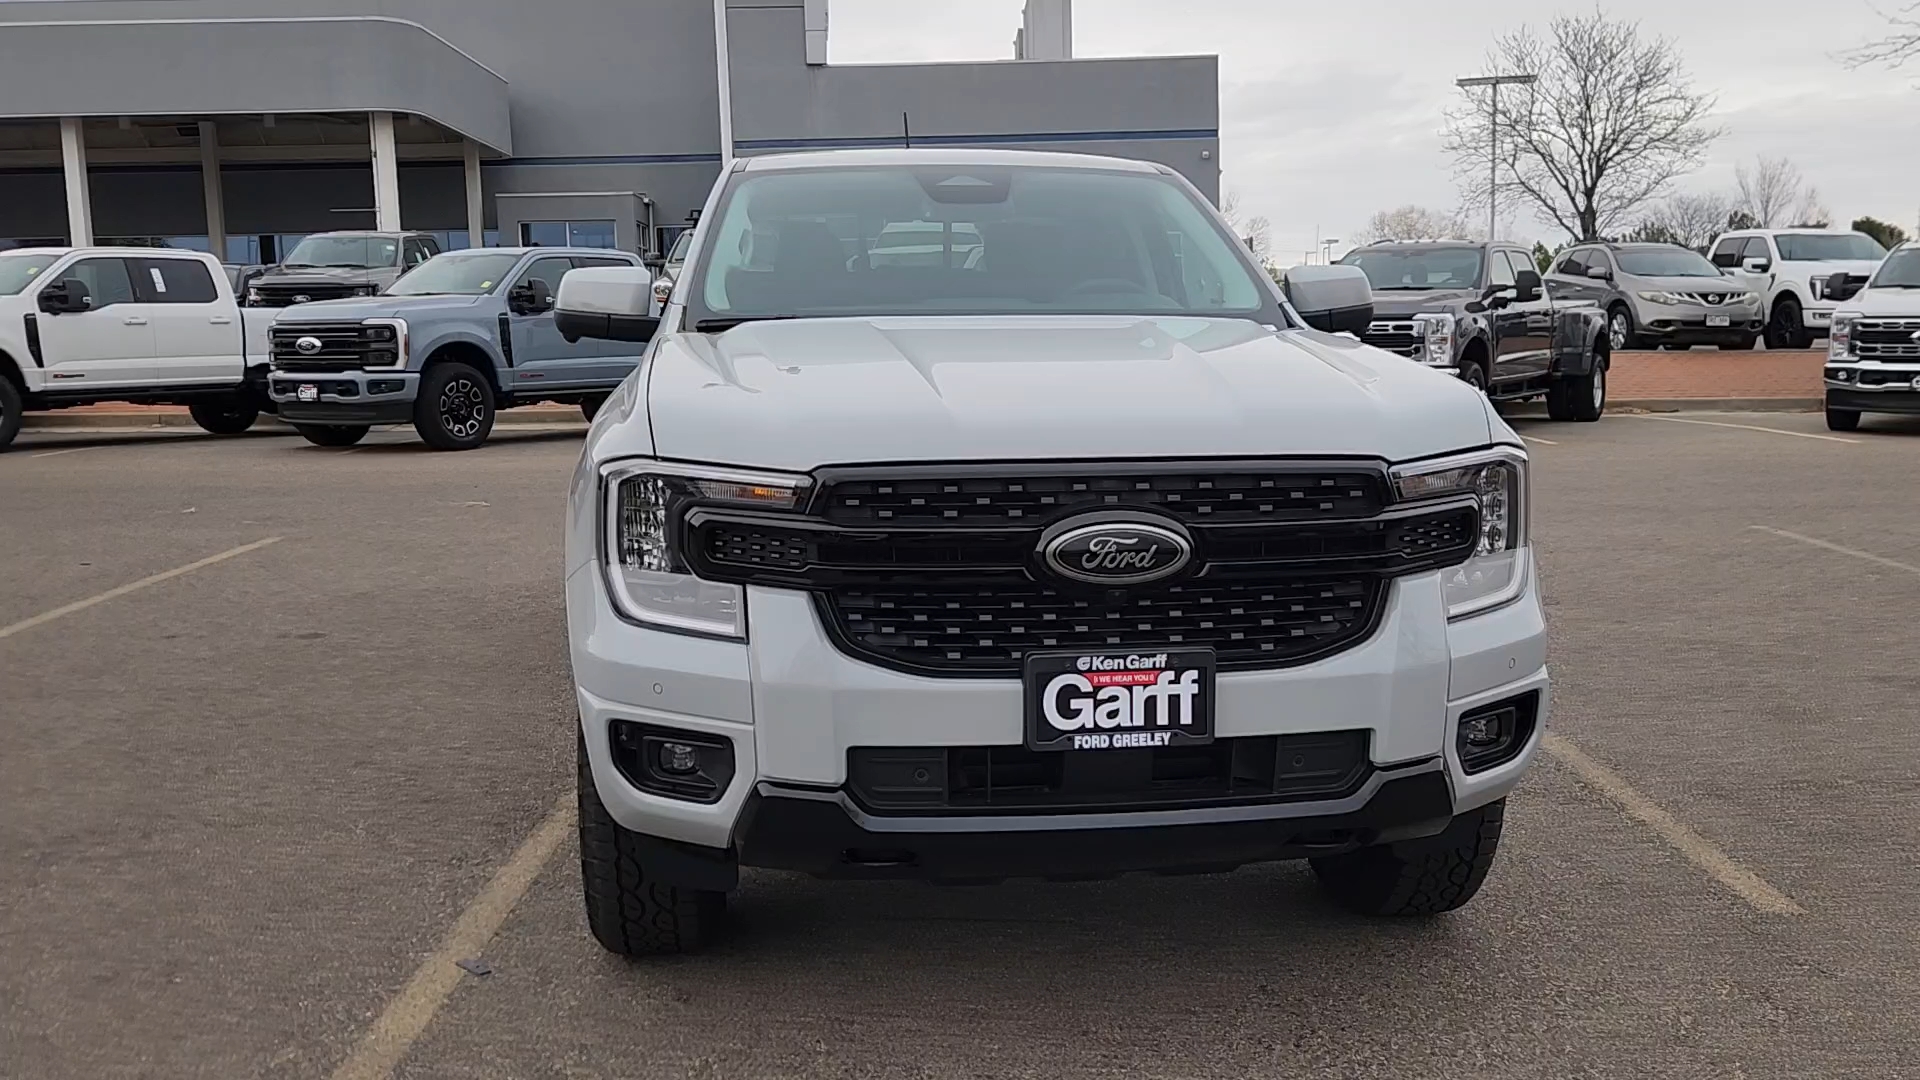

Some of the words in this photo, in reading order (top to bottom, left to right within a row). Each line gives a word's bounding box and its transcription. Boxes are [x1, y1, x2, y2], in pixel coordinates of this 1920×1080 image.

[1081, 536, 1158, 569] Ford
[1091, 655, 1124, 671] Ken
[1125, 653, 1168, 670] Garff
[1098, 675, 1111, 683] WE
[1112, 674, 1132, 683] HEAR
[1133, 674, 1150, 682] YOU
[1042, 669, 1199, 731] Garff
[1074, 733, 1110, 750] FORD
[1112, 731, 1171, 748] GREELEY
